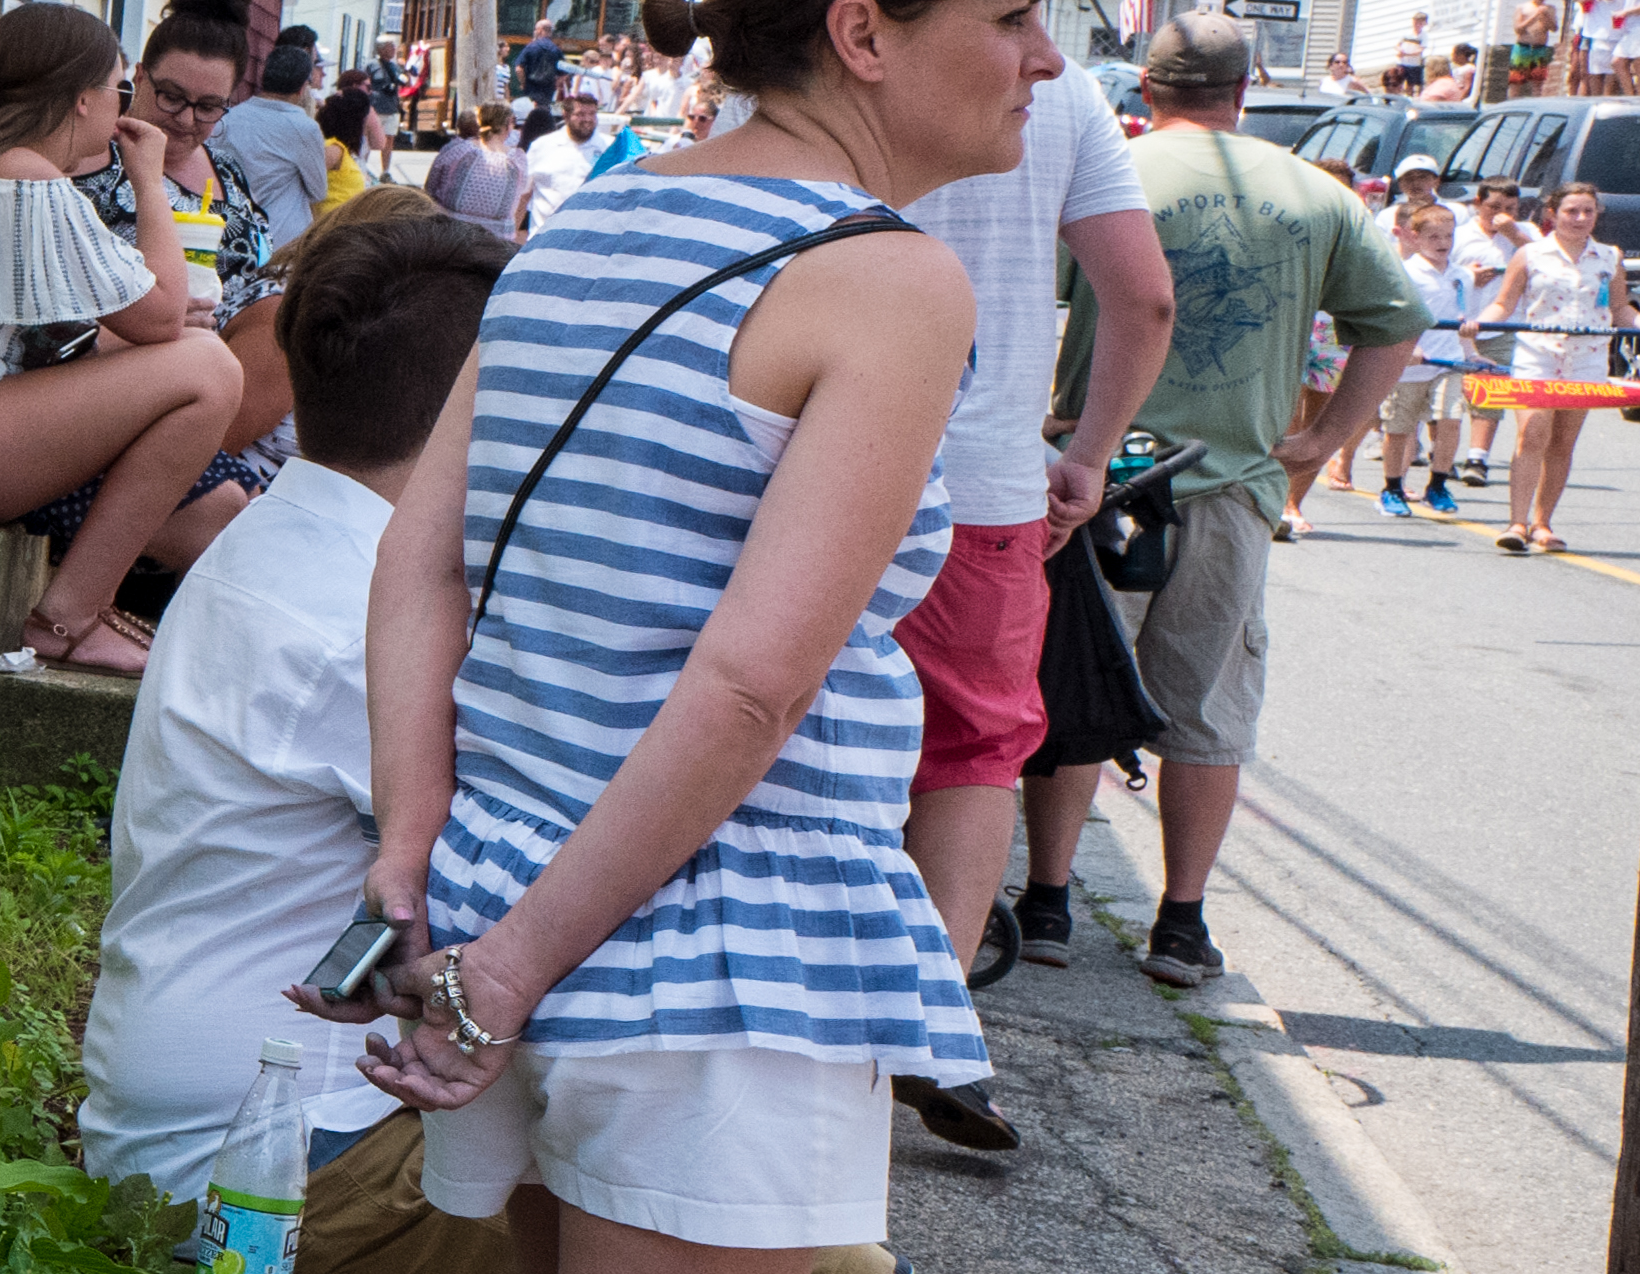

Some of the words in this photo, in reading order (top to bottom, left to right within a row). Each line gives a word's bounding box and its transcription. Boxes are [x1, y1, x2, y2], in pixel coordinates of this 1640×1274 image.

[1246, 3, 1264, 13] ONE
[1269, 5, 1291, 14] WAY
[1258, 200, 1312, 251] BLUE
[1544, 381, 1628, 398] JOSEPHINE
